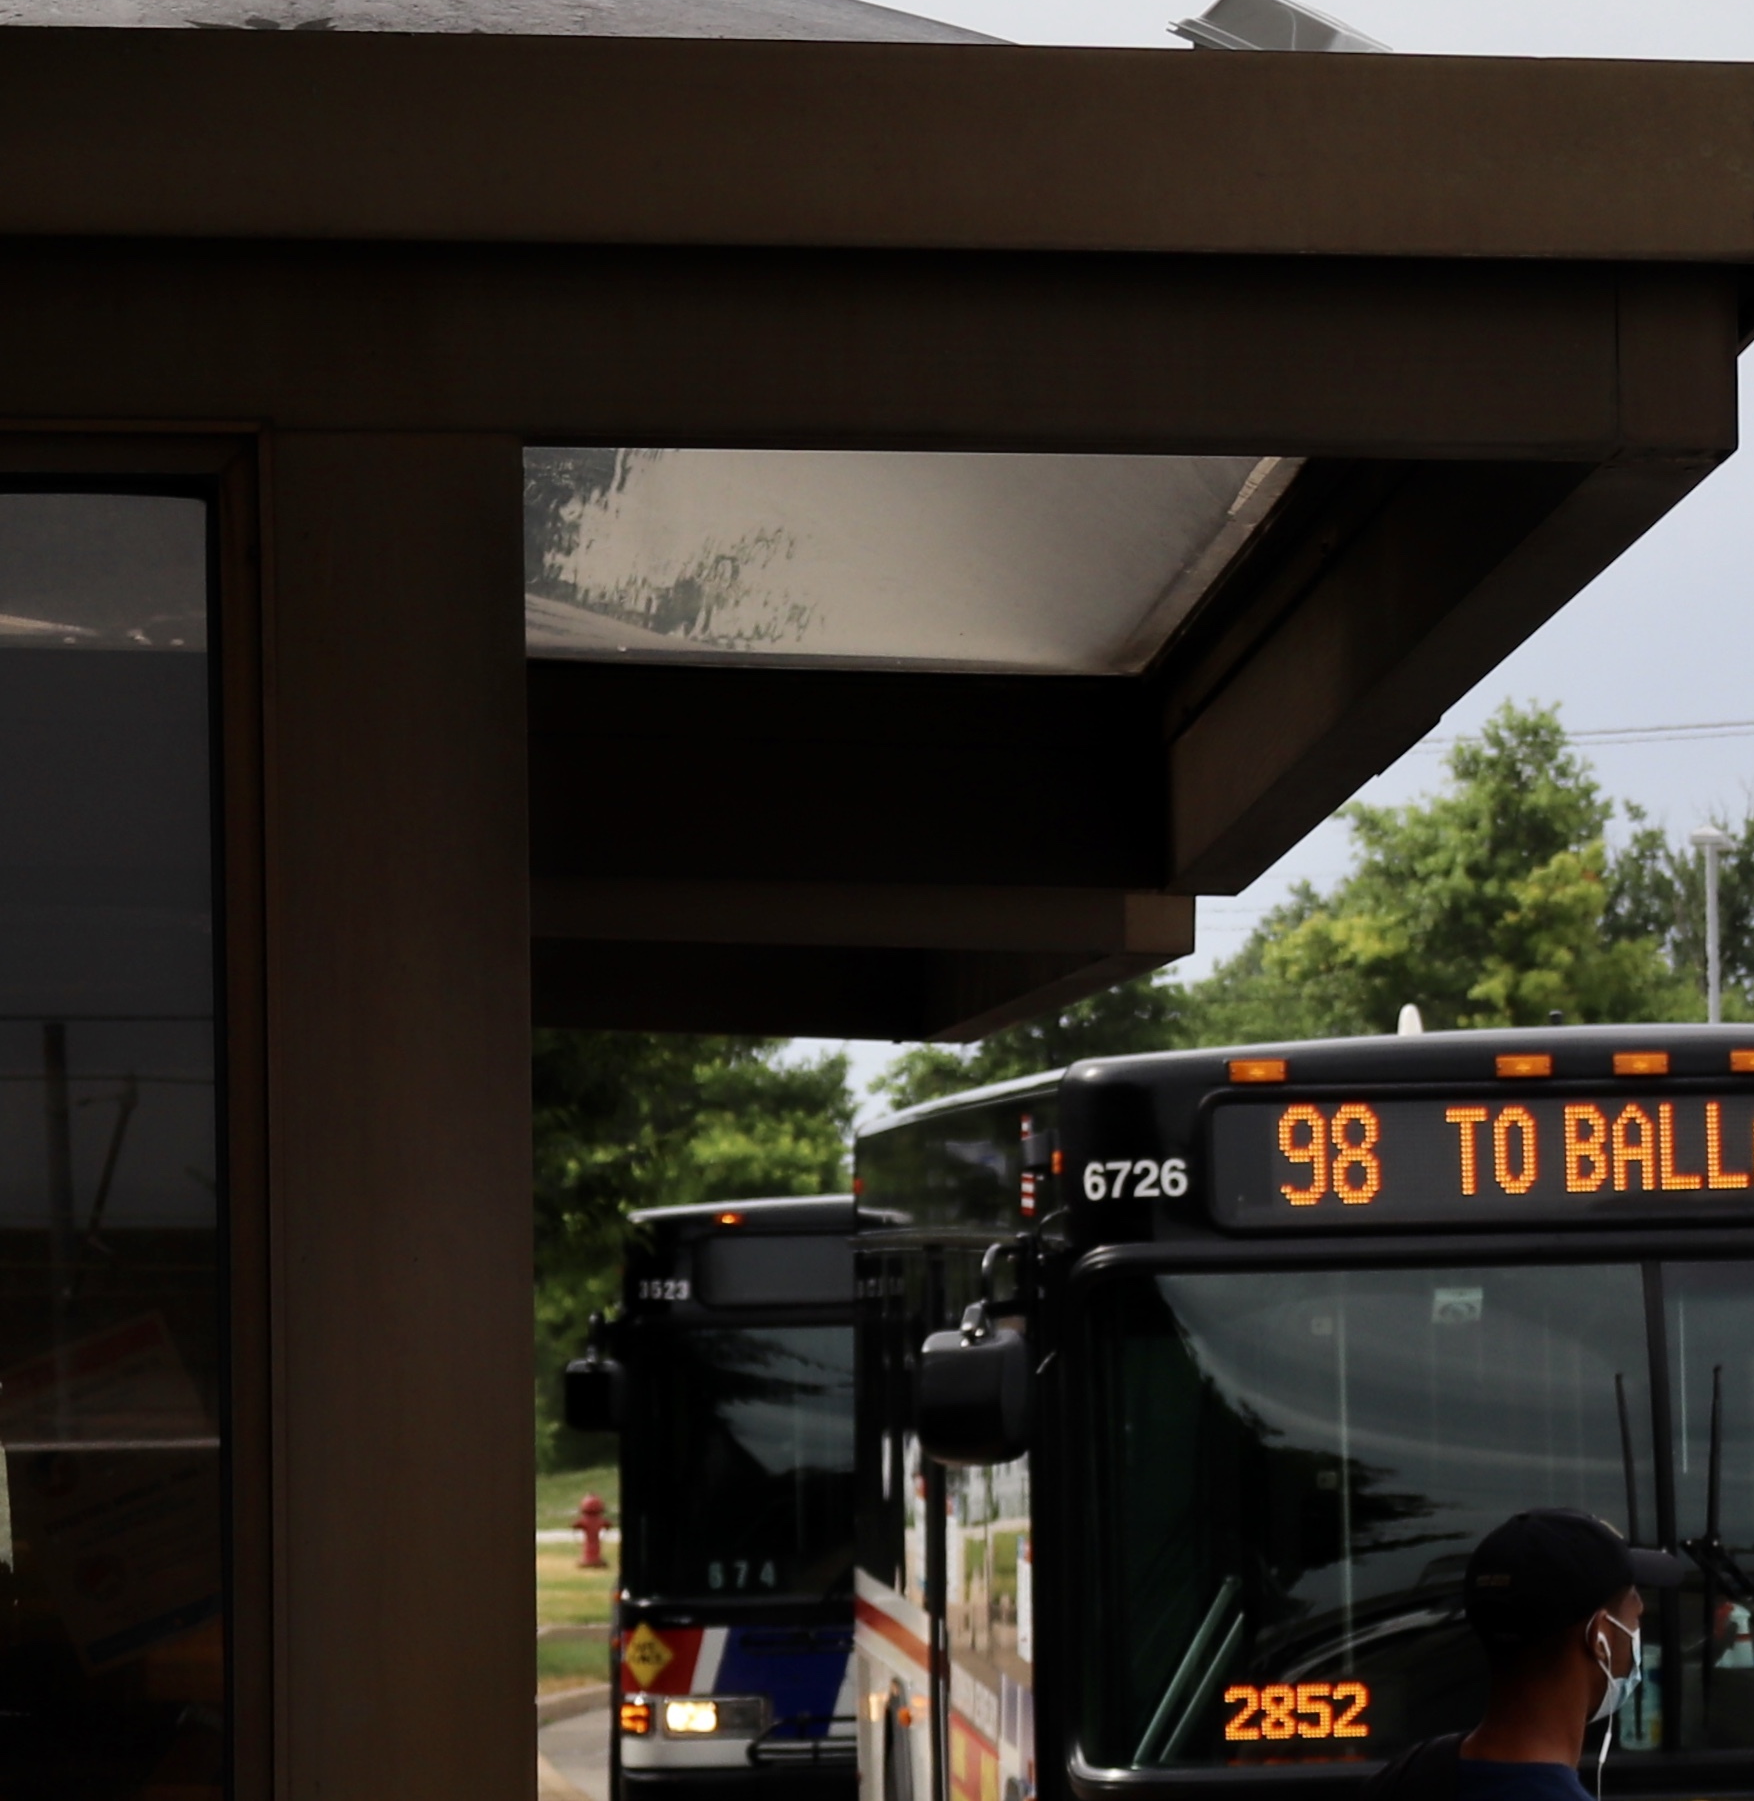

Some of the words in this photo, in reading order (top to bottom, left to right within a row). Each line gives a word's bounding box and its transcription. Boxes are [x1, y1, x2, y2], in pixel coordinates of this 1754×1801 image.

[1083, 1158, 1188, 1201] 6726
[1278, 1103, 1381, 1206] 98
[1445, 1105, 1539, 1196] TO
[1224, 1682, 1369, 1741] 2852
